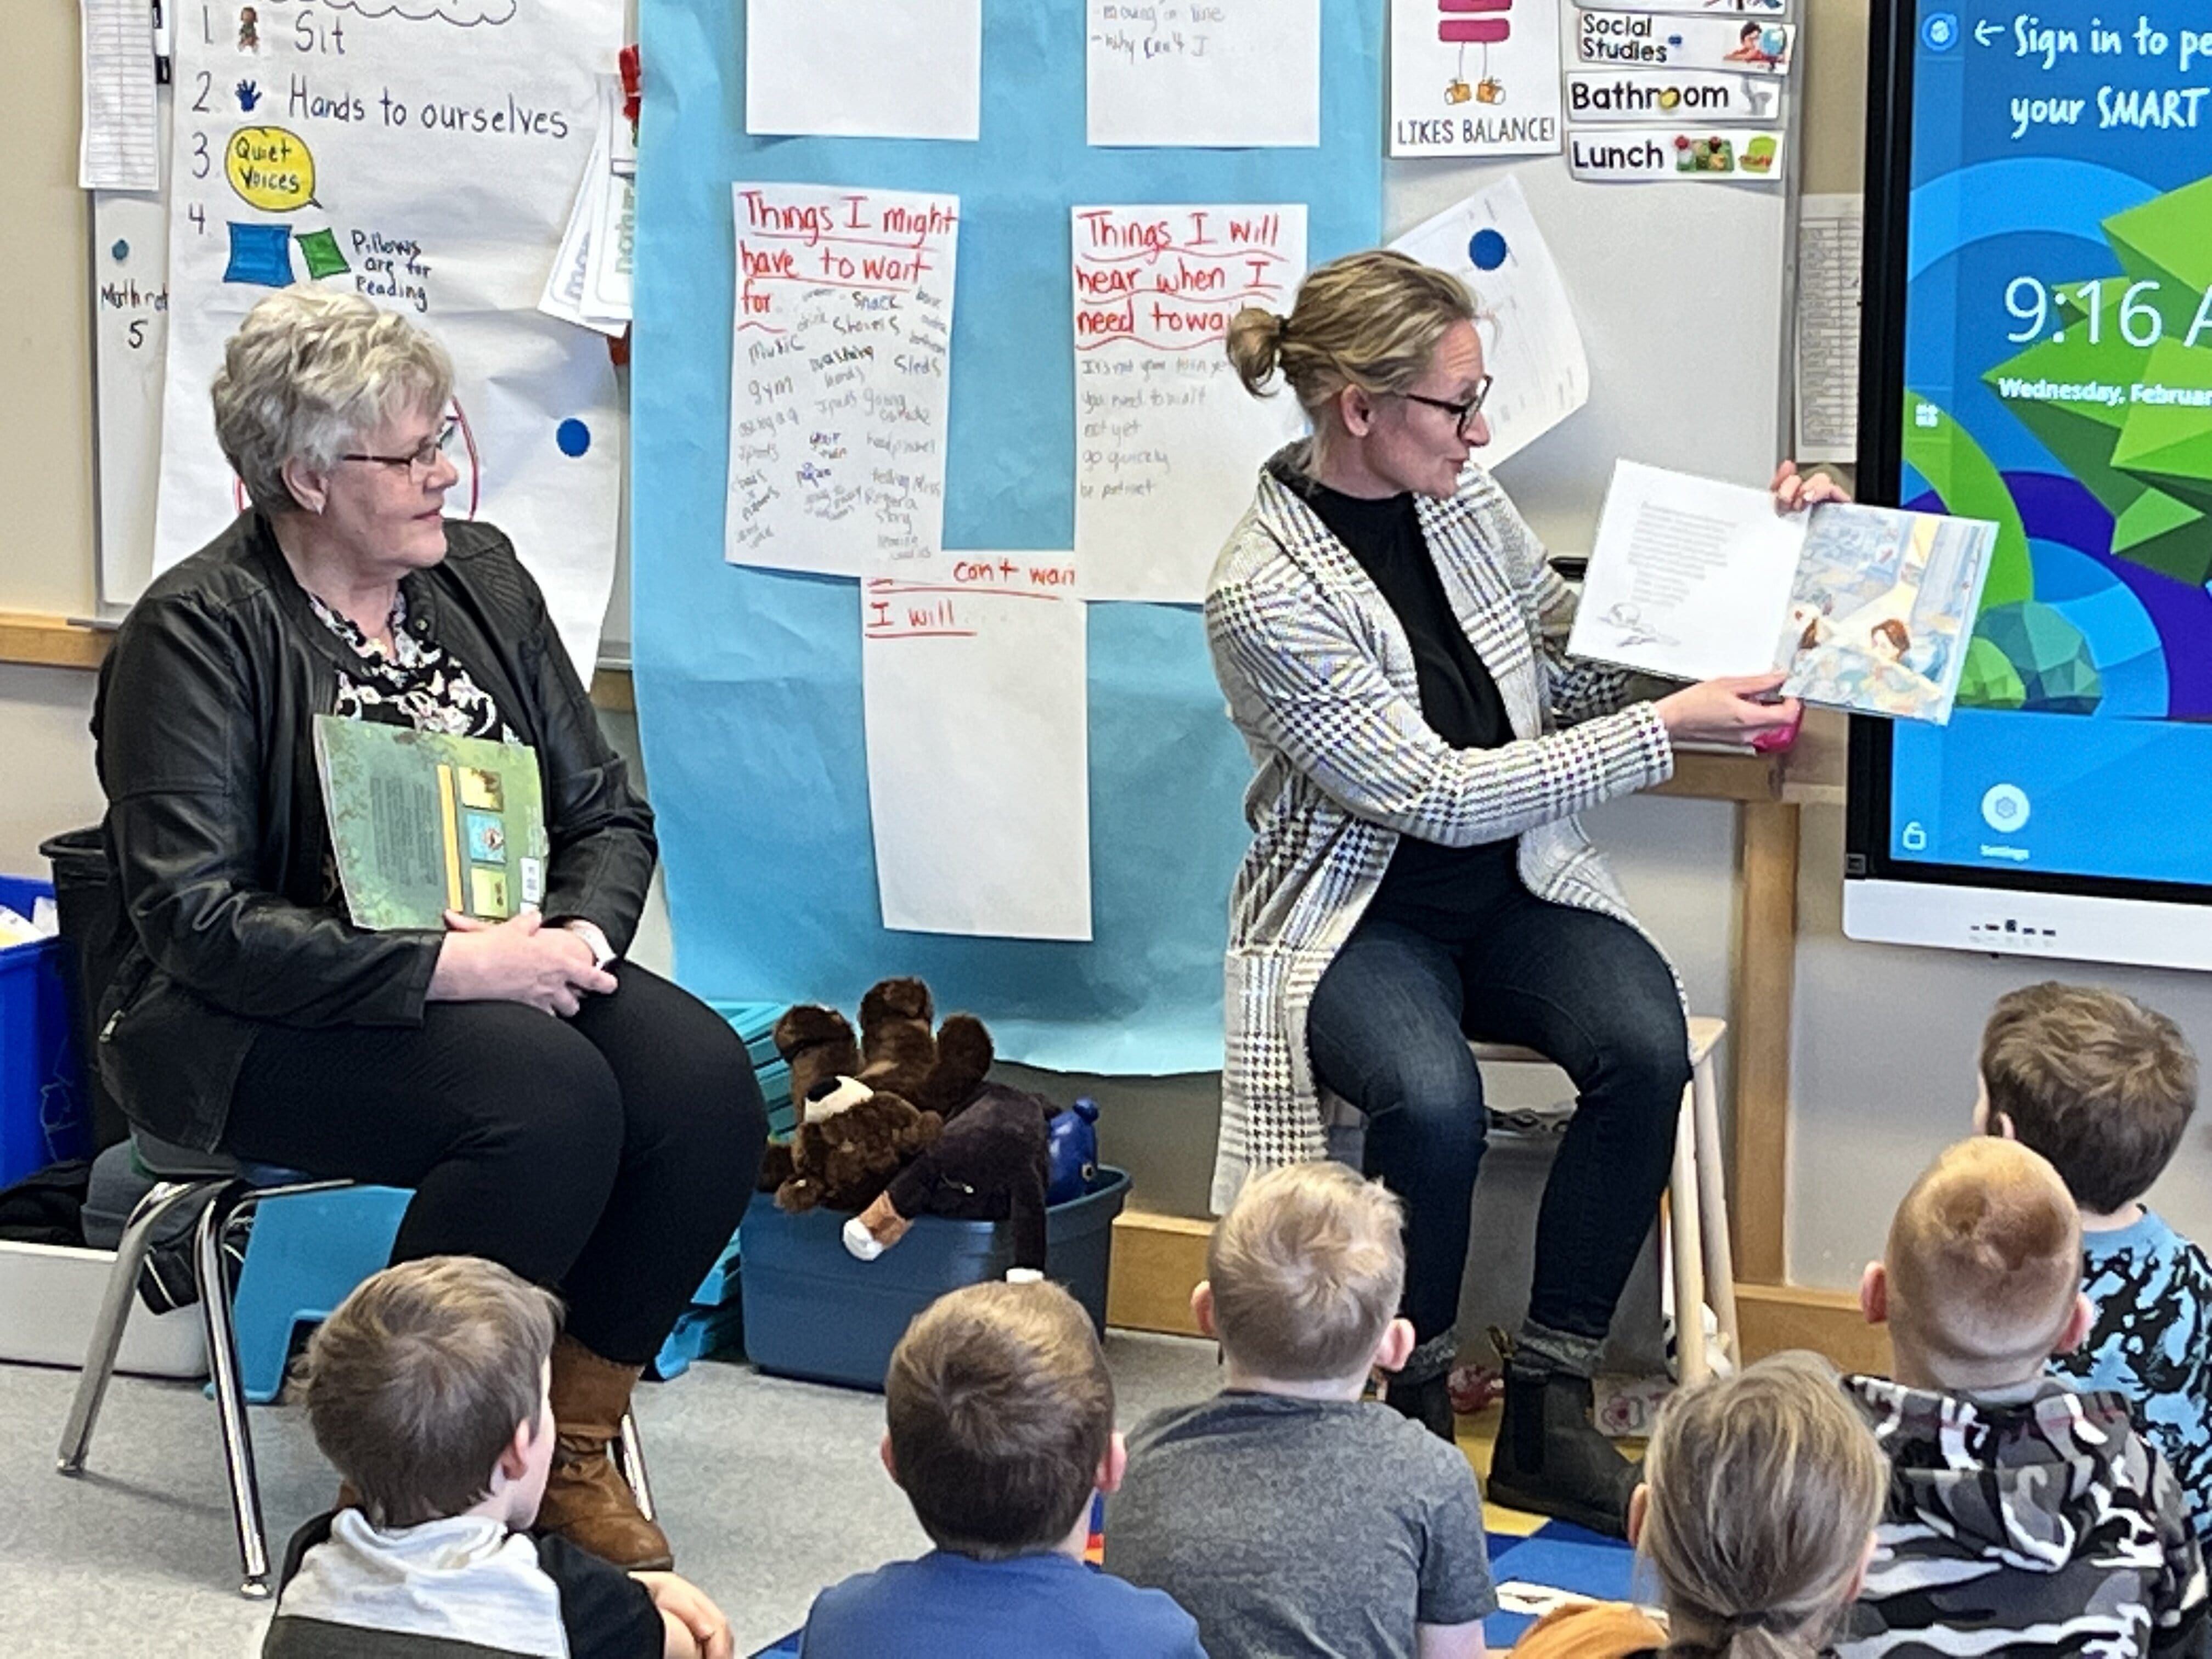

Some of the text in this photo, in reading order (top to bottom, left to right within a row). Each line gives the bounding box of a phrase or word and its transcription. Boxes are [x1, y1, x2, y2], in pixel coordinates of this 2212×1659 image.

[294, 9, 346, 55] Sit
[1583, 14, 1652, 37] Social
[2014, 13, 2079, 70] Sign
[2091, 18, 2121, 54] in
[2132, 15, 2169, 55] to
[1582, 36, 1668, 63] Studies
[289, 73, 365, 122] Hands
[379, 86, 407, 126] to
[420, 92, 568, 139] ourselves
[2011, 85, 2211, 139] your SMART
[1397, 117, 1555, 145] LIKES BALANCE!
[236, 136, 292, 162] Quiet
[1572, 141, 1664, 169] Lunch
[239, 165, 300, 194] Voices
[737, 190, 959, 249] Things I might
[351, 229, 421, 261] Pillows
[1076, 210, 1280, 266] Things I will
[365, 257, 432, 279] are for
[740, 240, 933, 284] have to wait
[1075, 255, 1283, 294] hear when I
[740, 278, 771, 315] for
[2004, 276, 2163, 347] 9:16
[1076, 295, 1134, 336] need
[127, 318, 149, 349] 5
[1999, 377, 2126, 406] Wednesday,
[867, 599, 955, 628] I will
